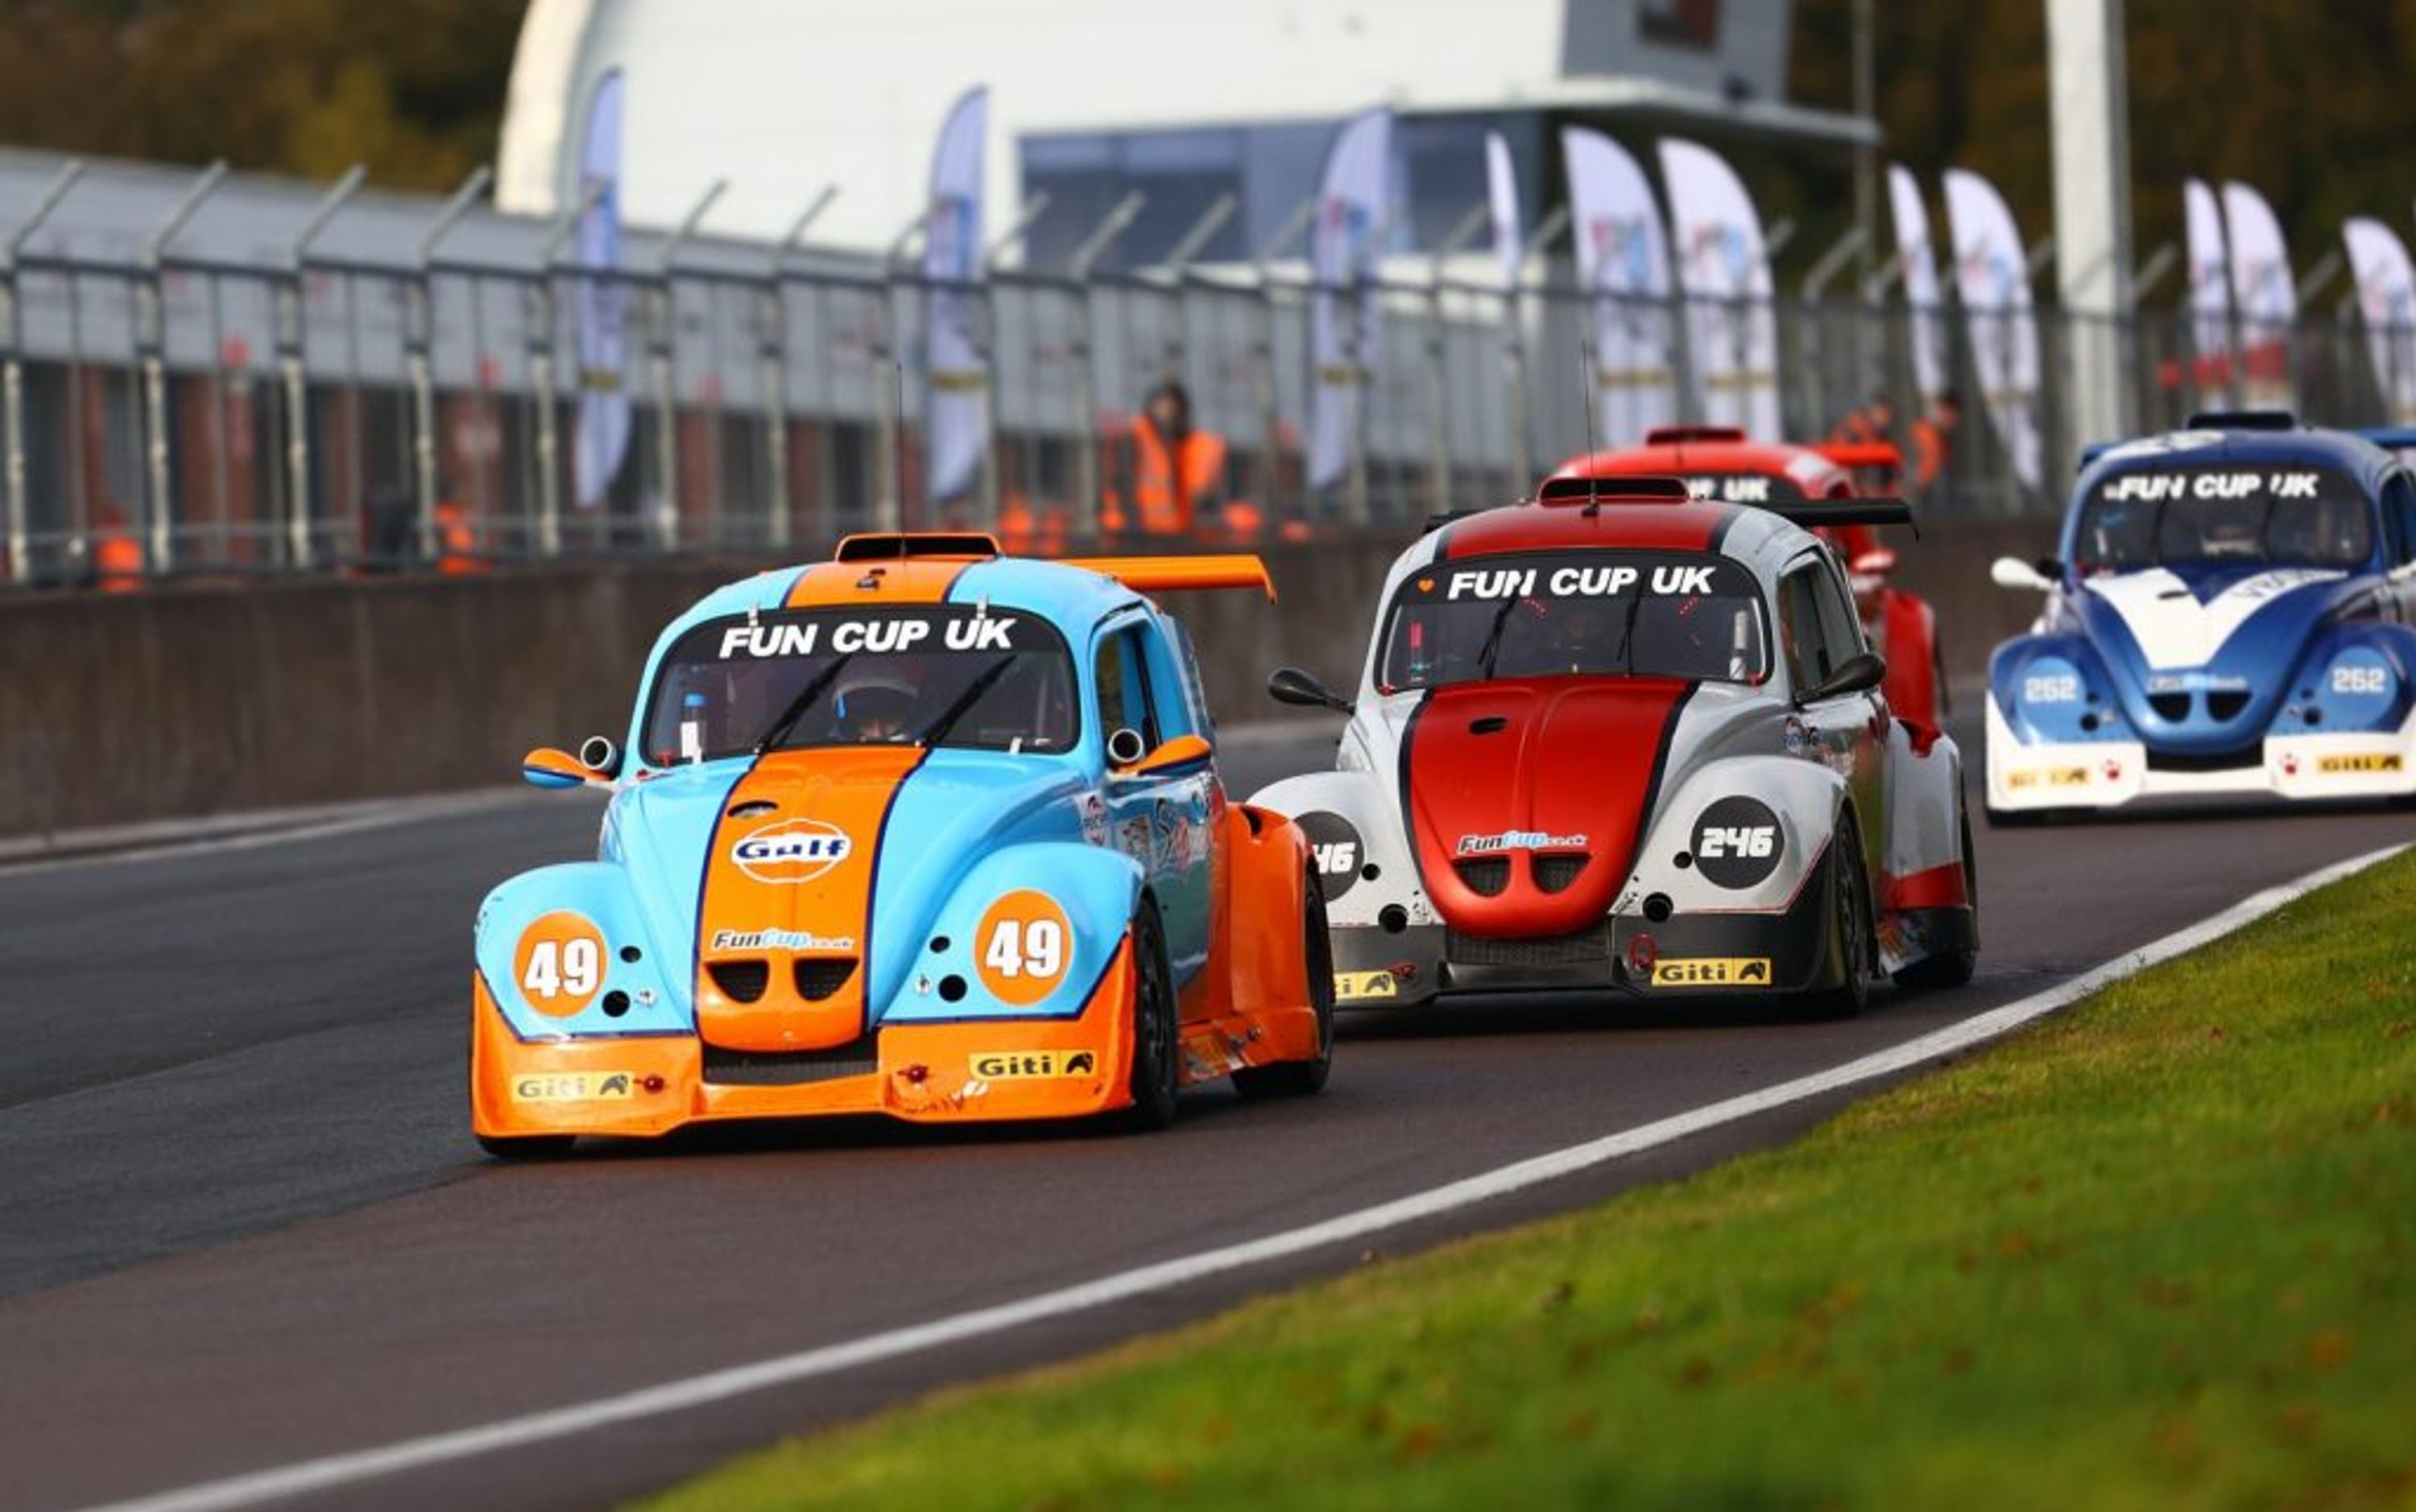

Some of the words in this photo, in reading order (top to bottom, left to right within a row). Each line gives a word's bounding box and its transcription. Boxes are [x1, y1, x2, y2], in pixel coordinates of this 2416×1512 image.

[1723, 478, 1770, 501] UK
[2119, 475, 2186, 501] FUN
[2194, 473, 2261, 499] CUP
[2269, 473, 2319, 498] UK
[1448, 568, 1536, 599] FUN
[1549, 567, 1637, 596] CUP
[1651, 565, 1717, 594] UK
[719, 623, 818, 659] FUN
[832, 619, 930, 652] CUP
[945, 618, 1017, 649] UK
[2331, 666, 2385, 693] 262
[736, 839, 846, 859] Gulf
[1699, 825, 1775, 857] 246
[1312, 842, 1355, 874] 46
[986, 919, 1061, 978] 49
[524, 938, 599, 998] 49
[1659, 963, 1726, 981] Giti
[977, 1056, 1051, 1077] Giti
[518, 1077, 586, 1097] Giti
